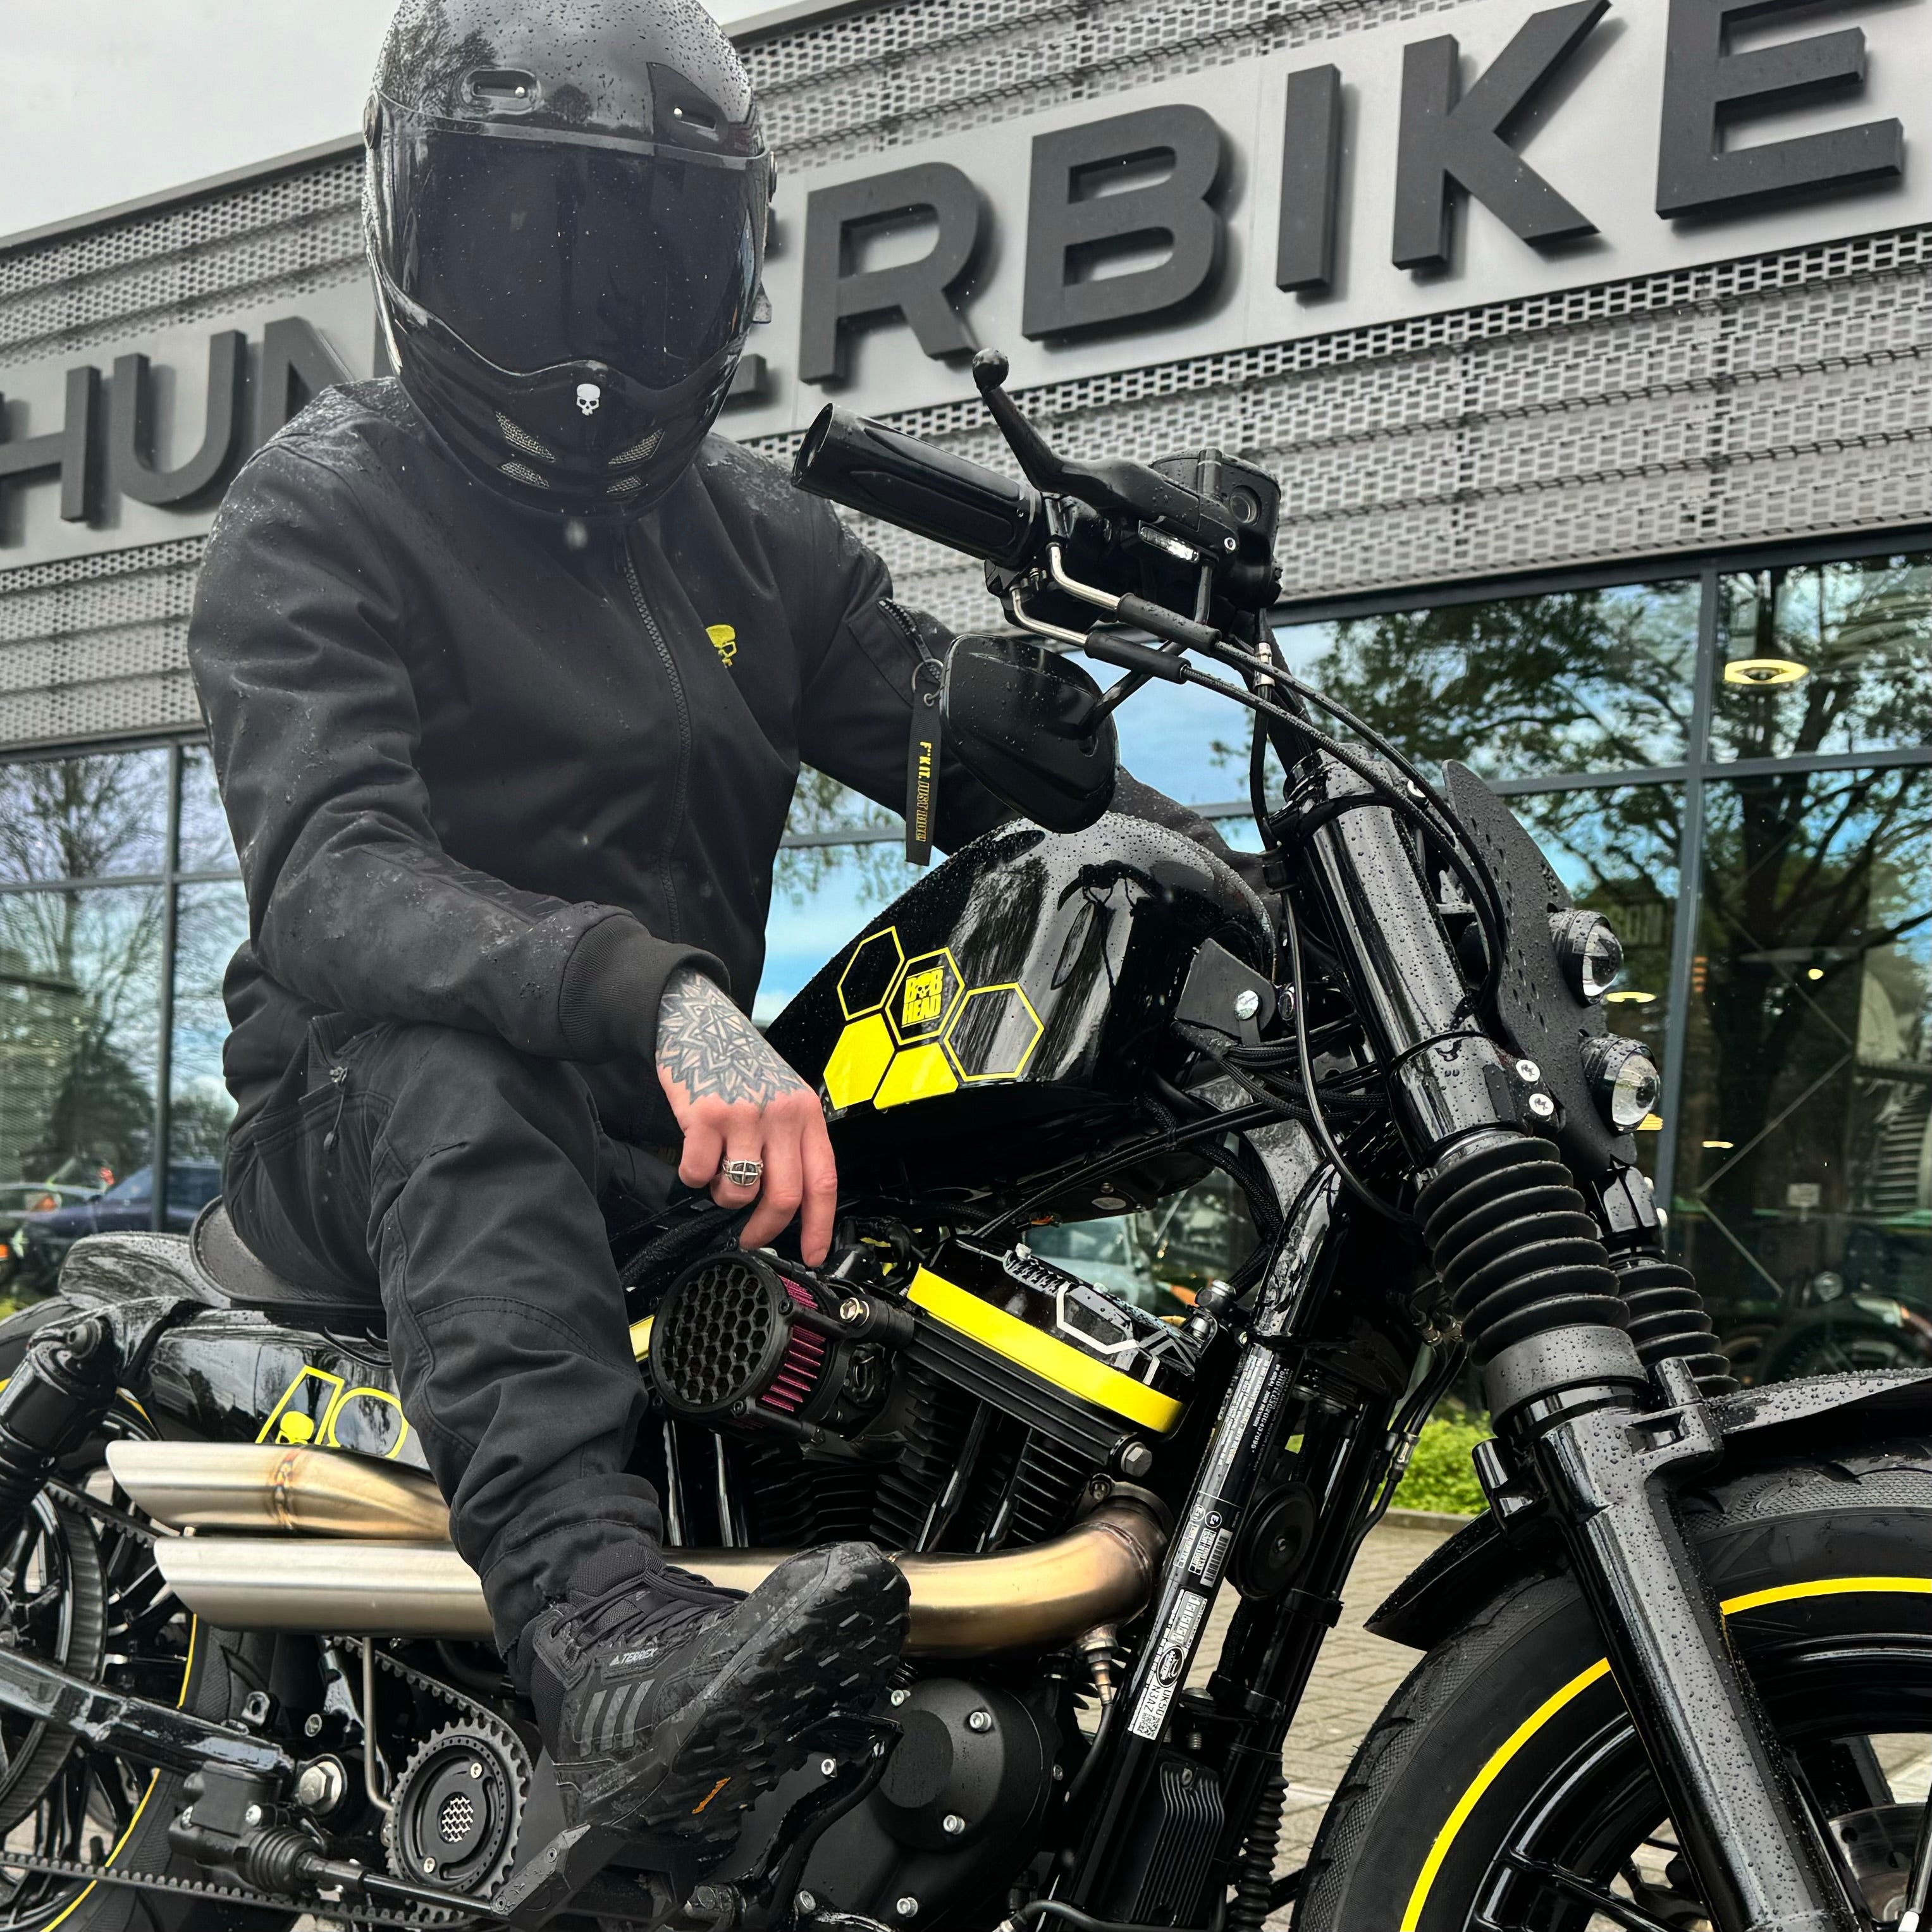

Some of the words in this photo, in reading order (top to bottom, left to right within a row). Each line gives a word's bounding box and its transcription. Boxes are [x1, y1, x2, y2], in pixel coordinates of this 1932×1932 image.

[902, 994, 942, 1025] HEAD
[1209, 1514, 1219, 1526] E4
[620, 1647, 658, 1664] TERREX
[1143, 1684, 1161, 1713] N3AZ
